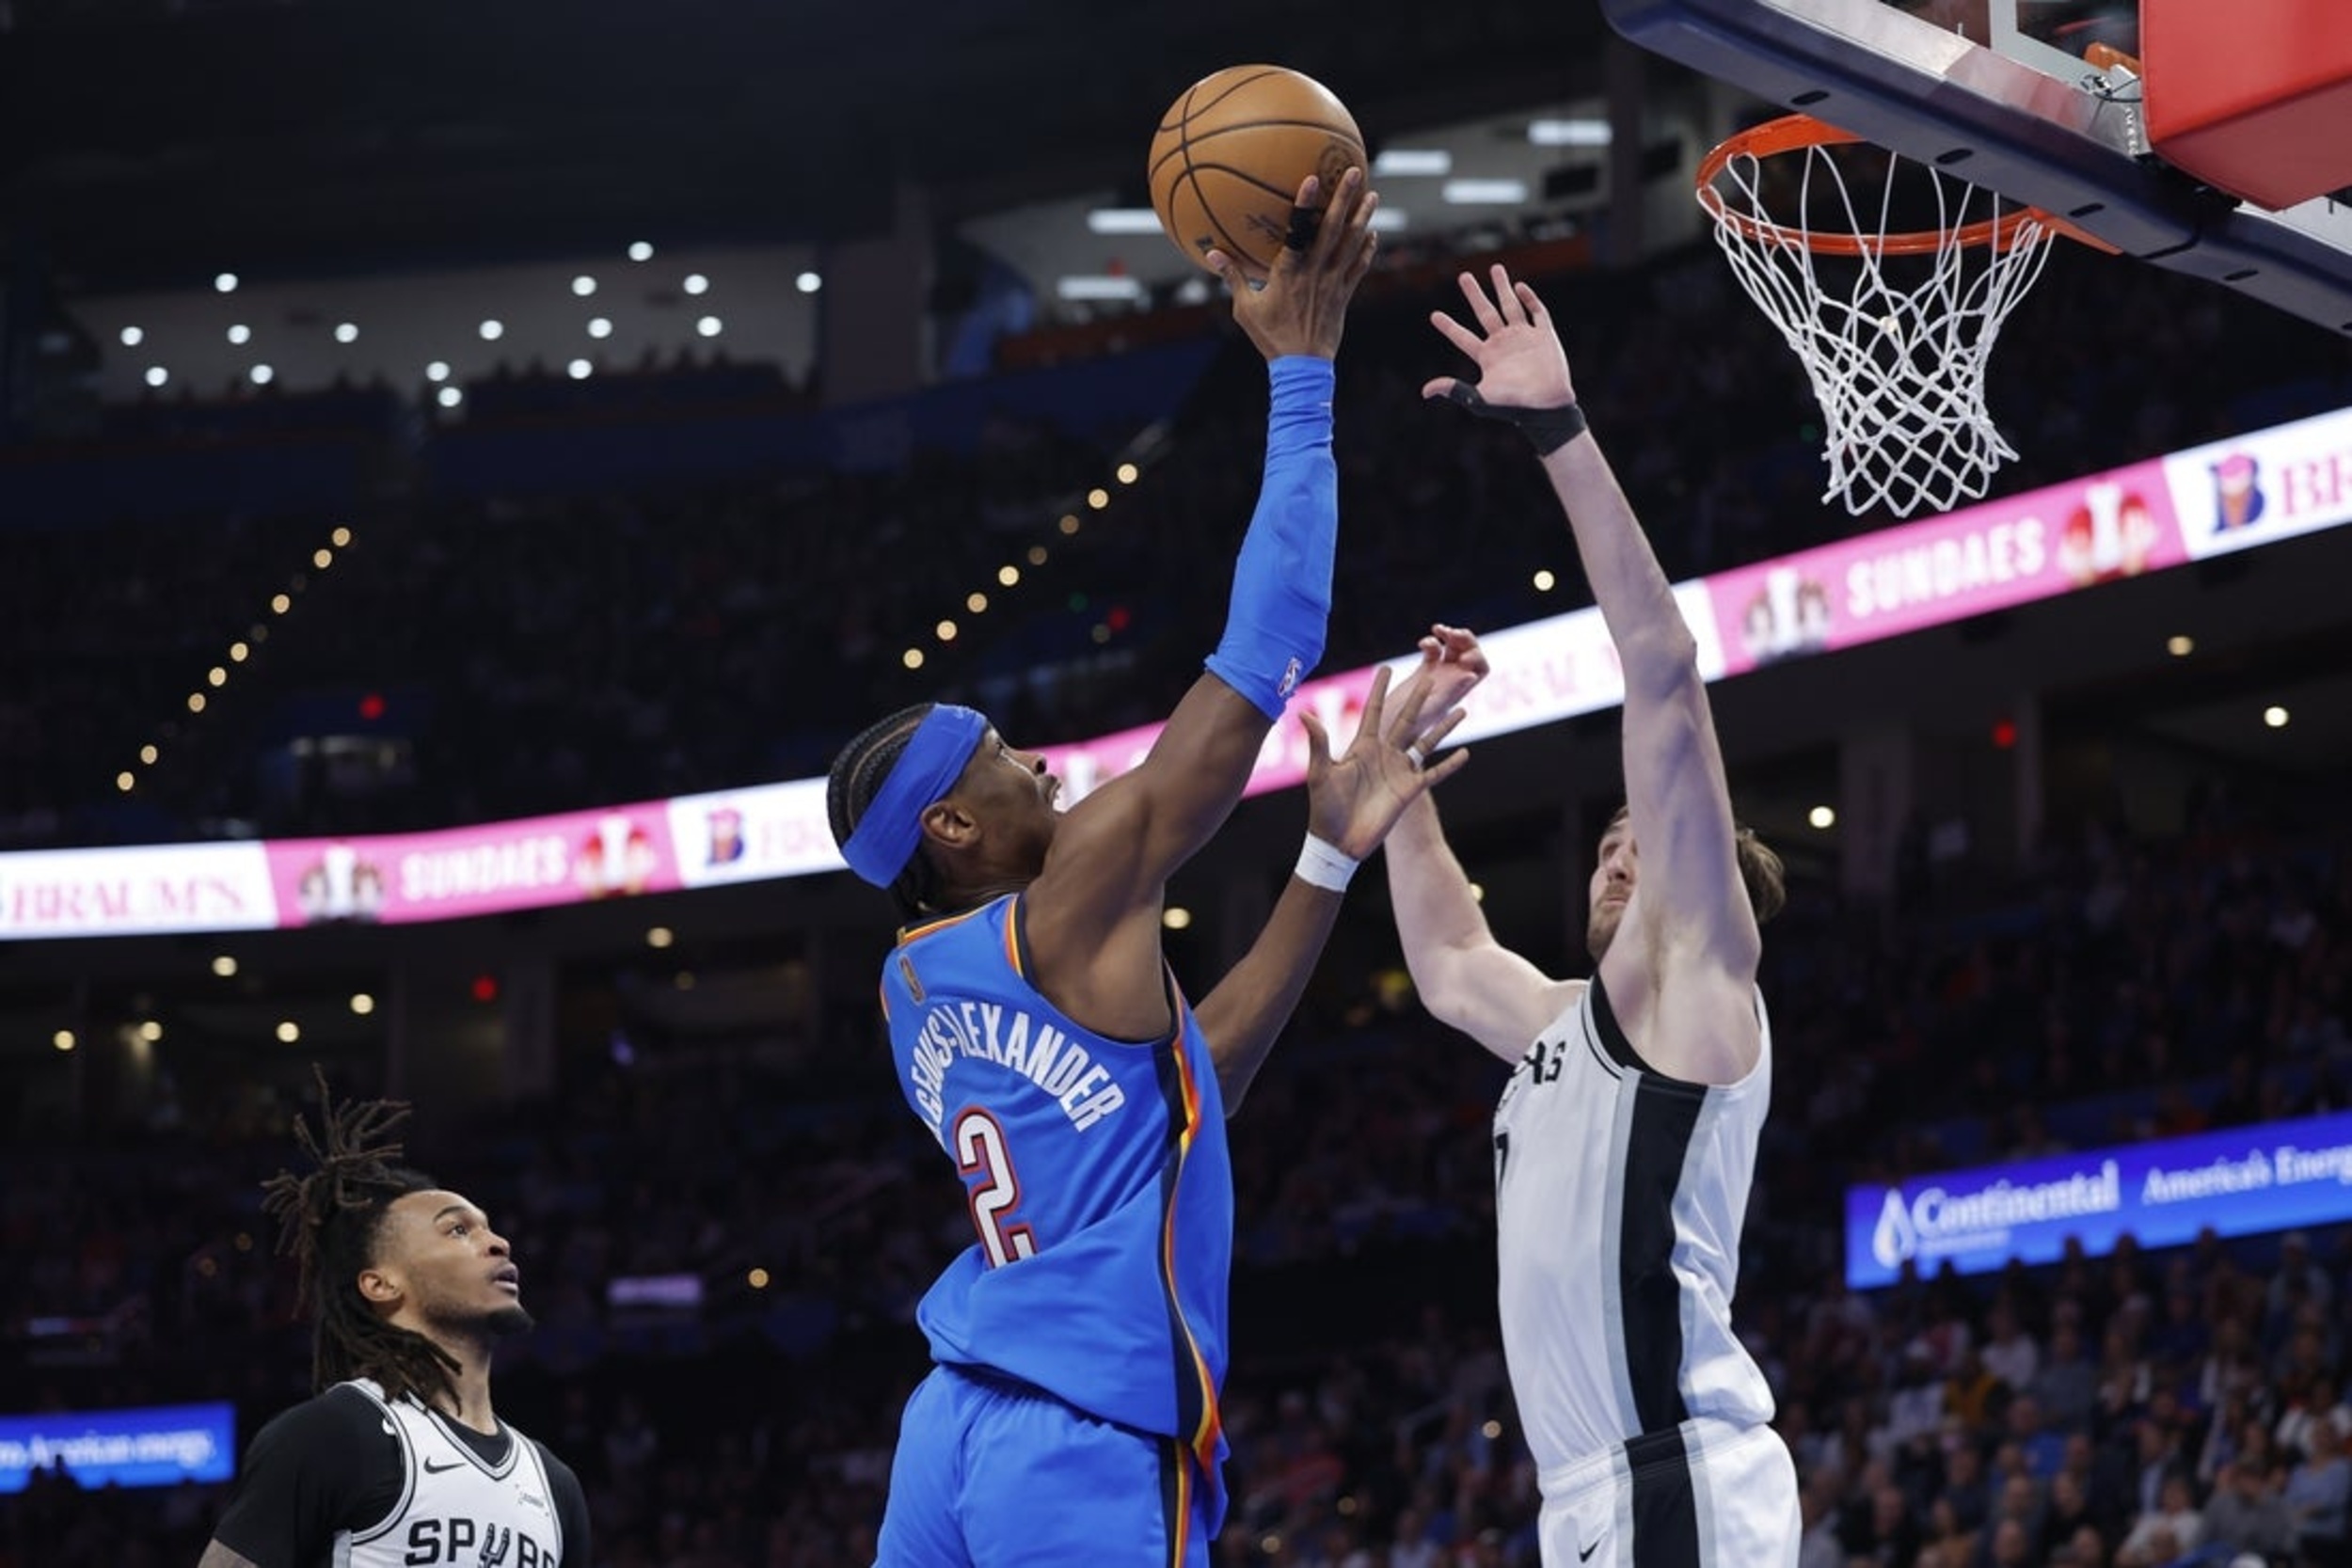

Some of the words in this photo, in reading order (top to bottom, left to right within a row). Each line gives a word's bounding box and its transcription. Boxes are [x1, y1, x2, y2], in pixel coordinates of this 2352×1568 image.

[1847, 518, 2046, 619] SUNDAES
[402, 834, 568, 902] SUNDAES
[953, 1104, 1040, 1271] 2
[1912, 1160, 2119, 1239] Continental
